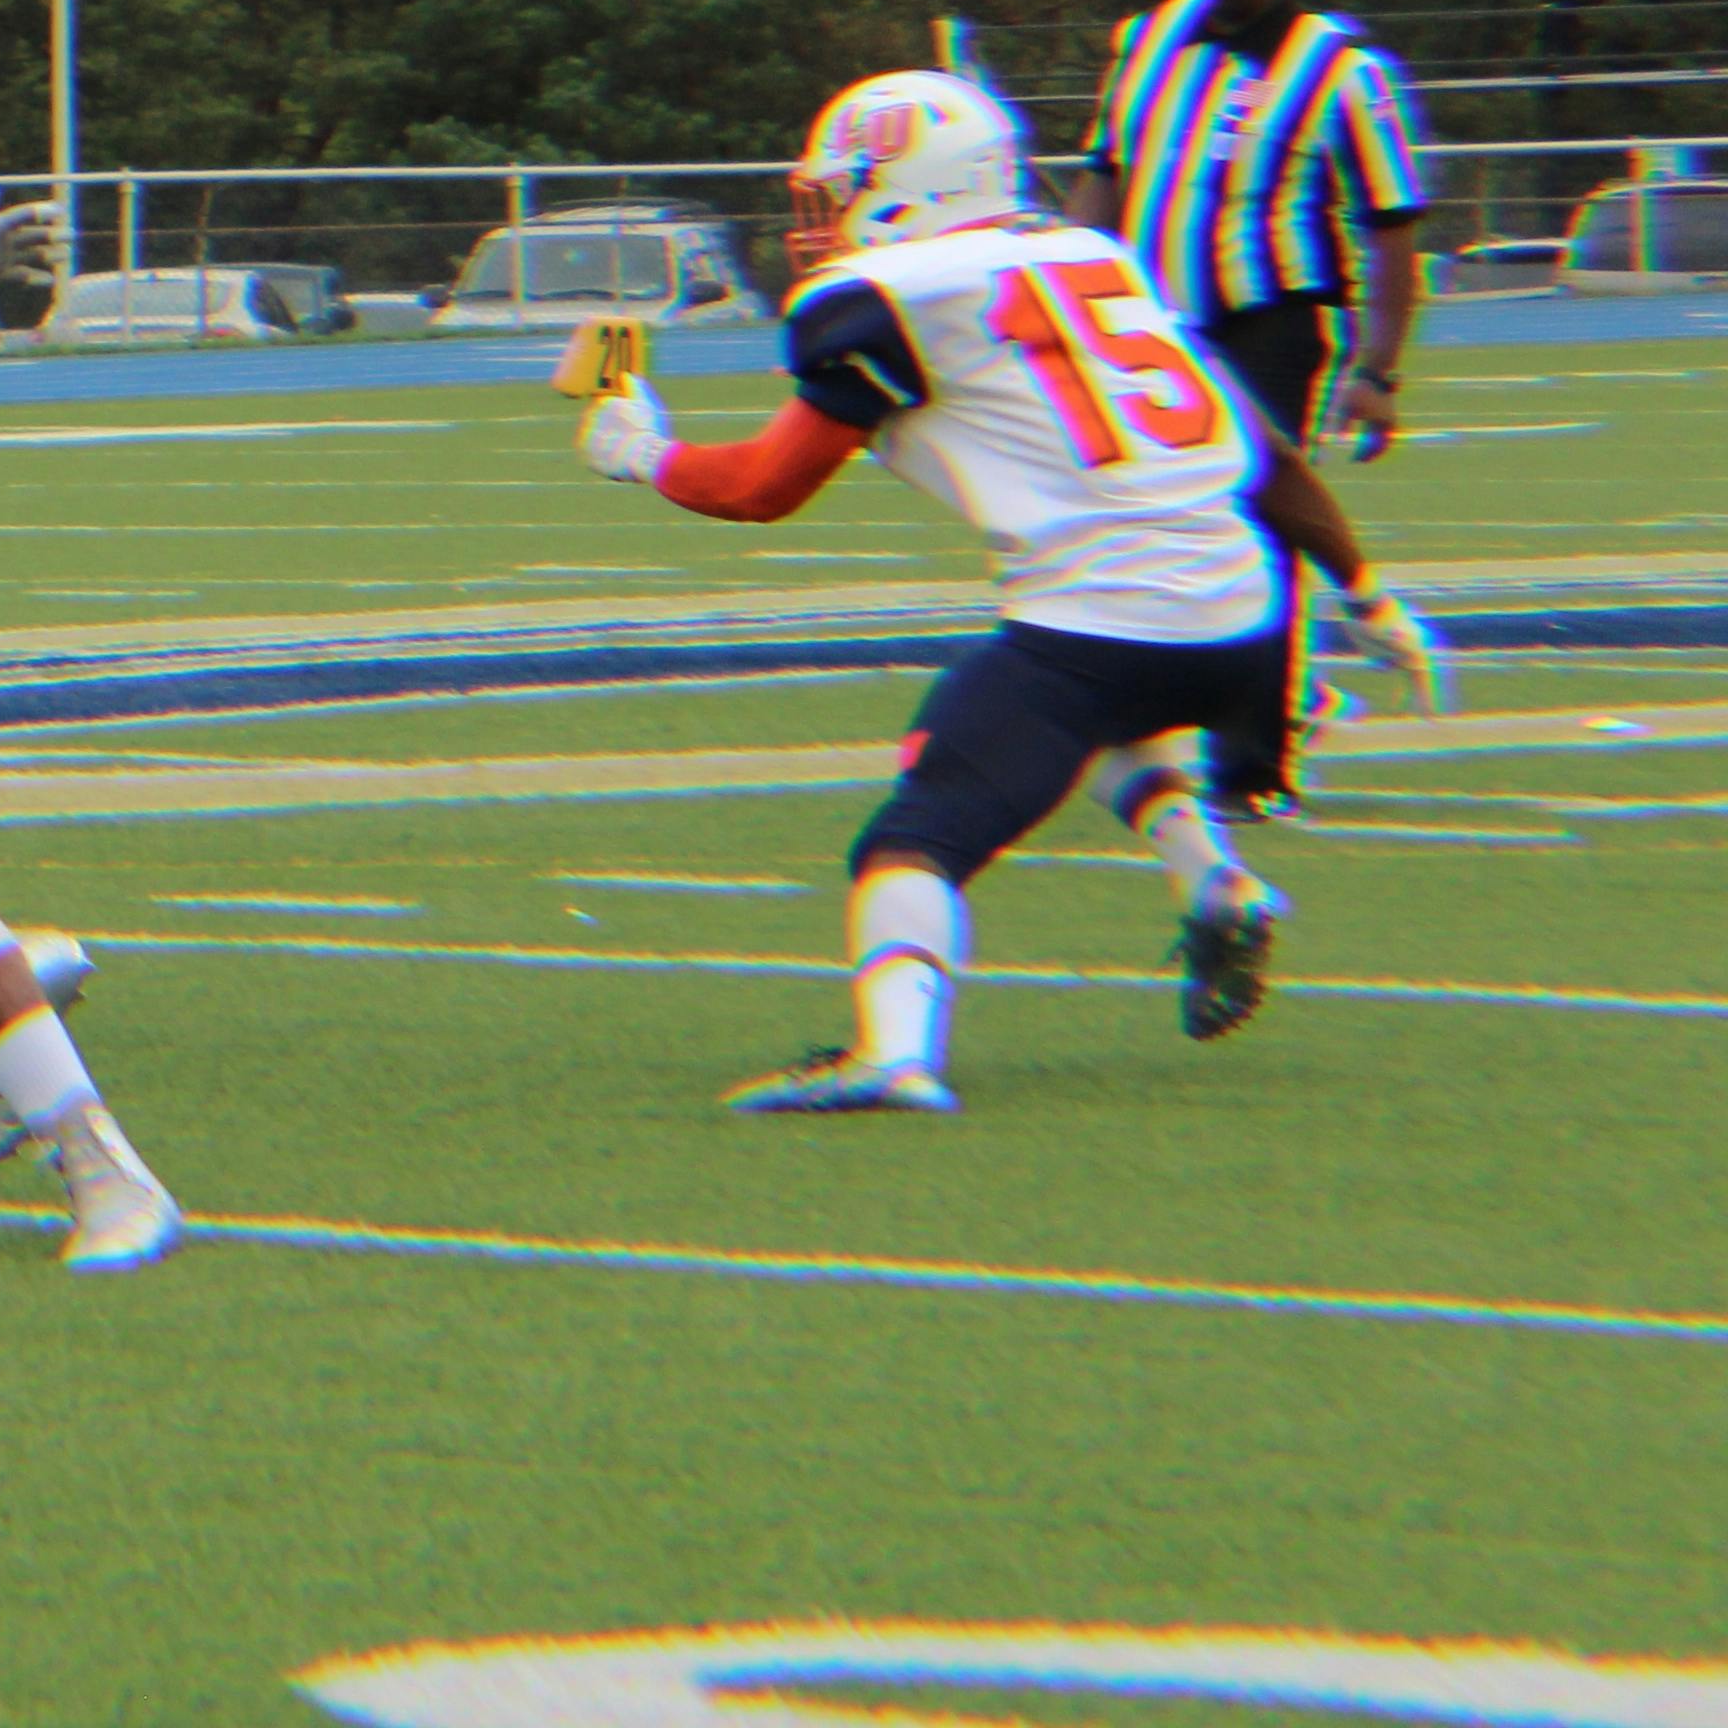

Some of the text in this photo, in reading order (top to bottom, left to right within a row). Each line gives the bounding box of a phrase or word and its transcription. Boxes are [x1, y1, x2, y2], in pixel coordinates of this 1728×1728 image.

[821, 101, 917, 161] LU
[597, 325, 631, 389] 20
[984, 259, 1219, 469] 15
